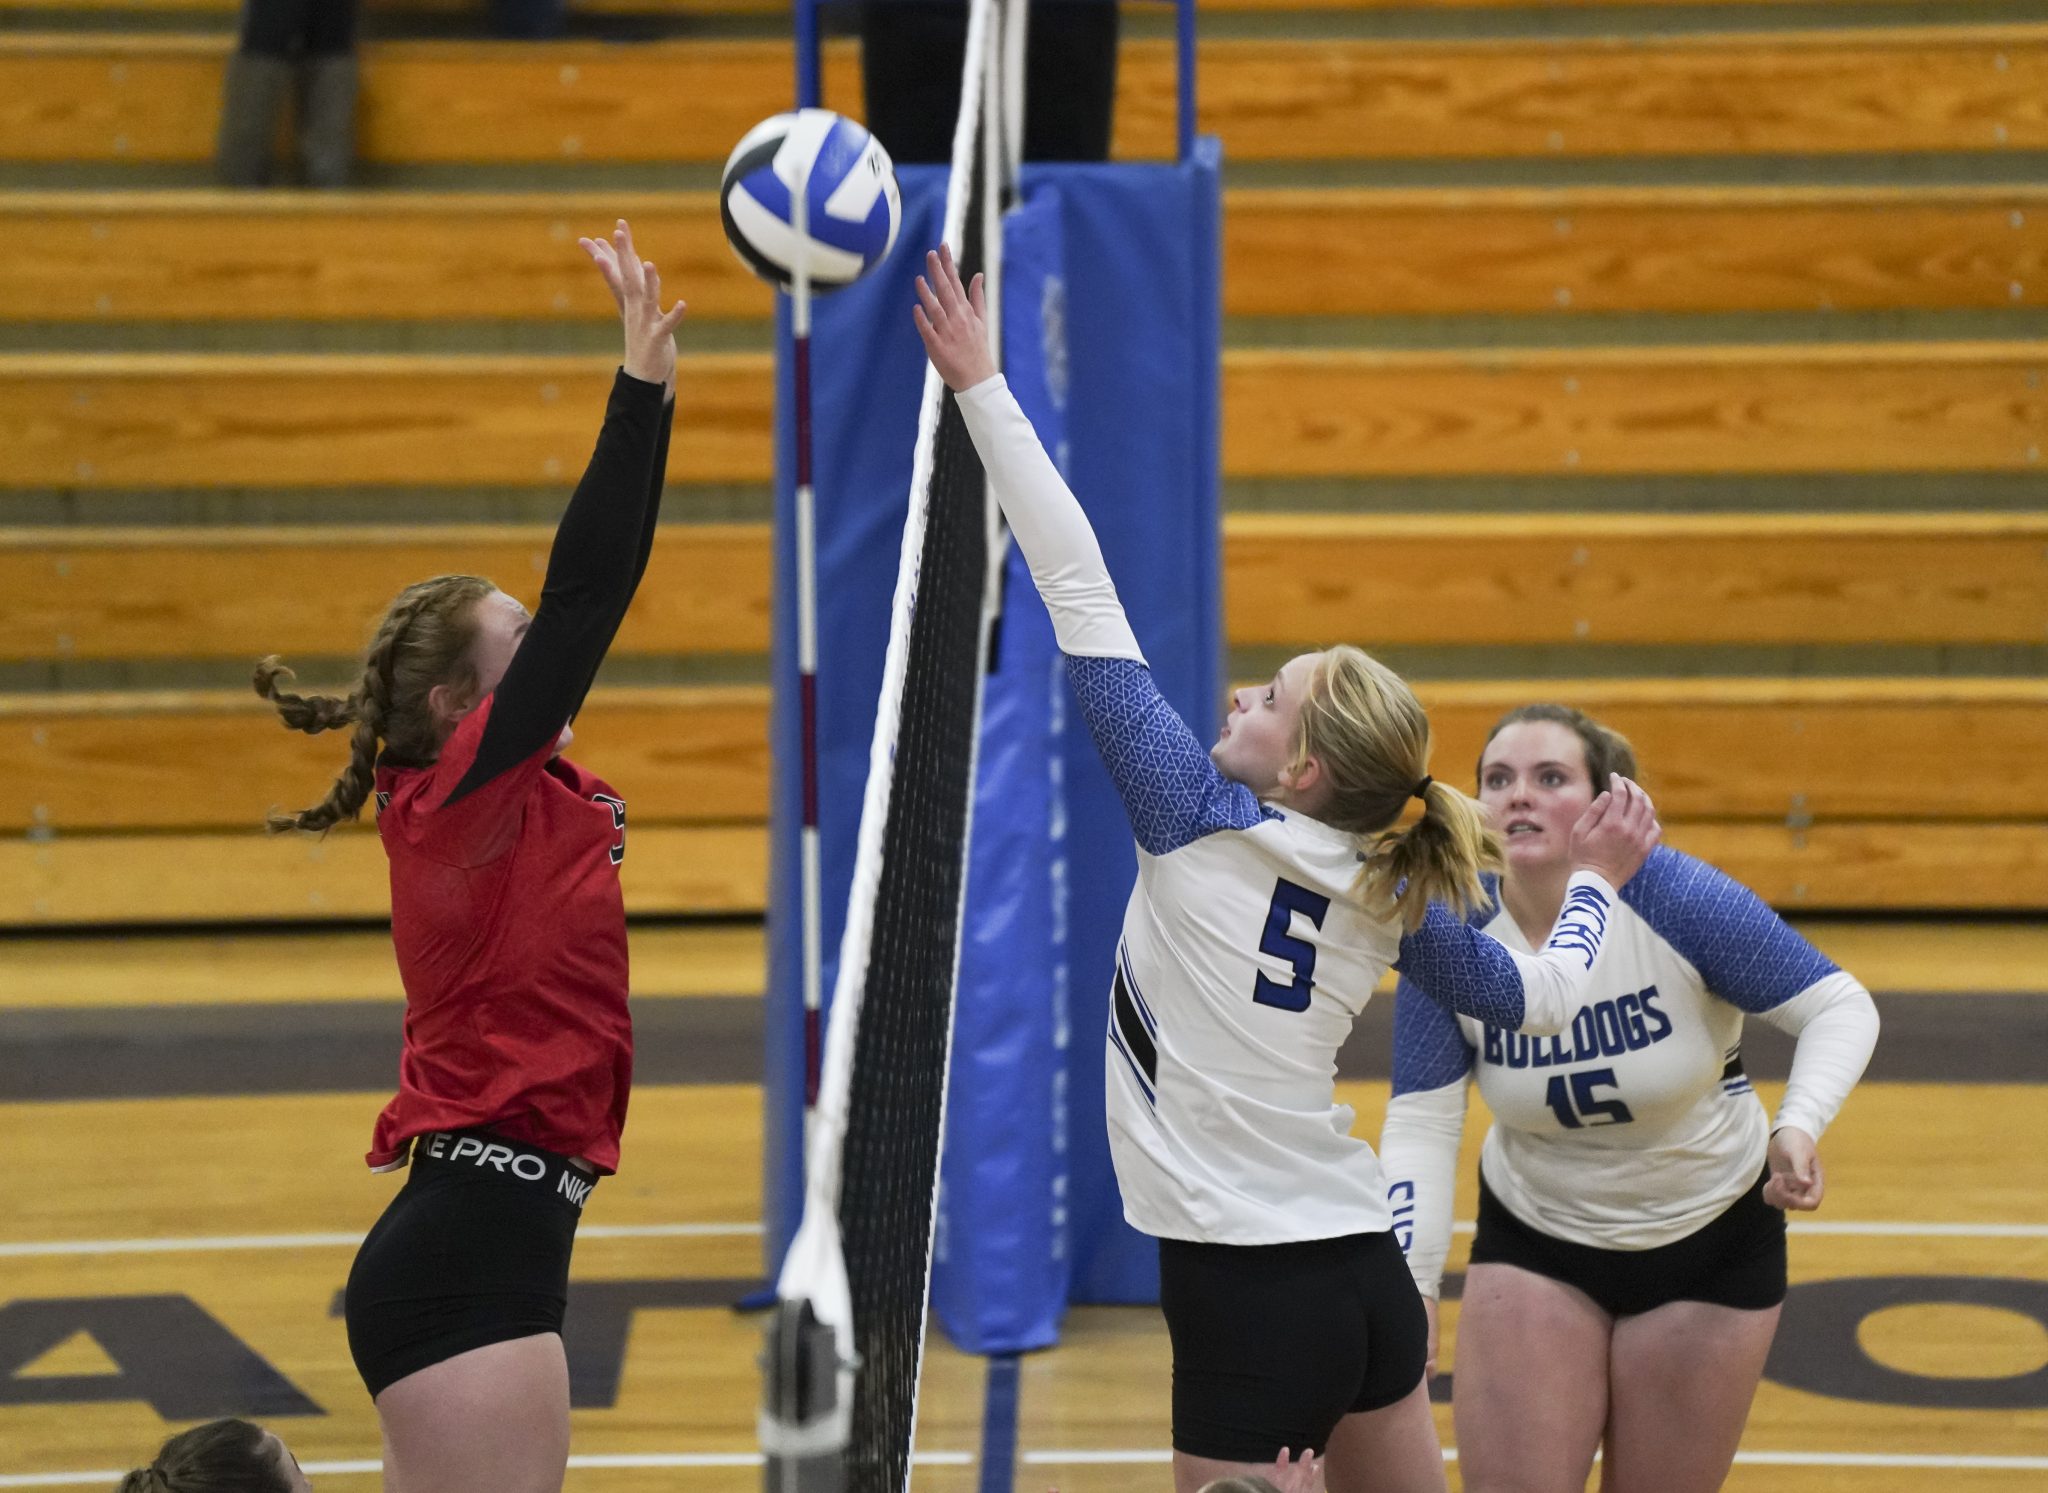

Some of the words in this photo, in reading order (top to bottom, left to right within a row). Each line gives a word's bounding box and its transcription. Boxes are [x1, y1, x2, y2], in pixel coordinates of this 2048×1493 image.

[1253, 876, 1331, 1013] 5
[1548, 885, 1610, 971] MCHS
[1484, 985, 1672, 1069] BULLDOGS
[1546, 1068, 1635, 1129] 15
[450, 1138, 546, 1181] PRO
